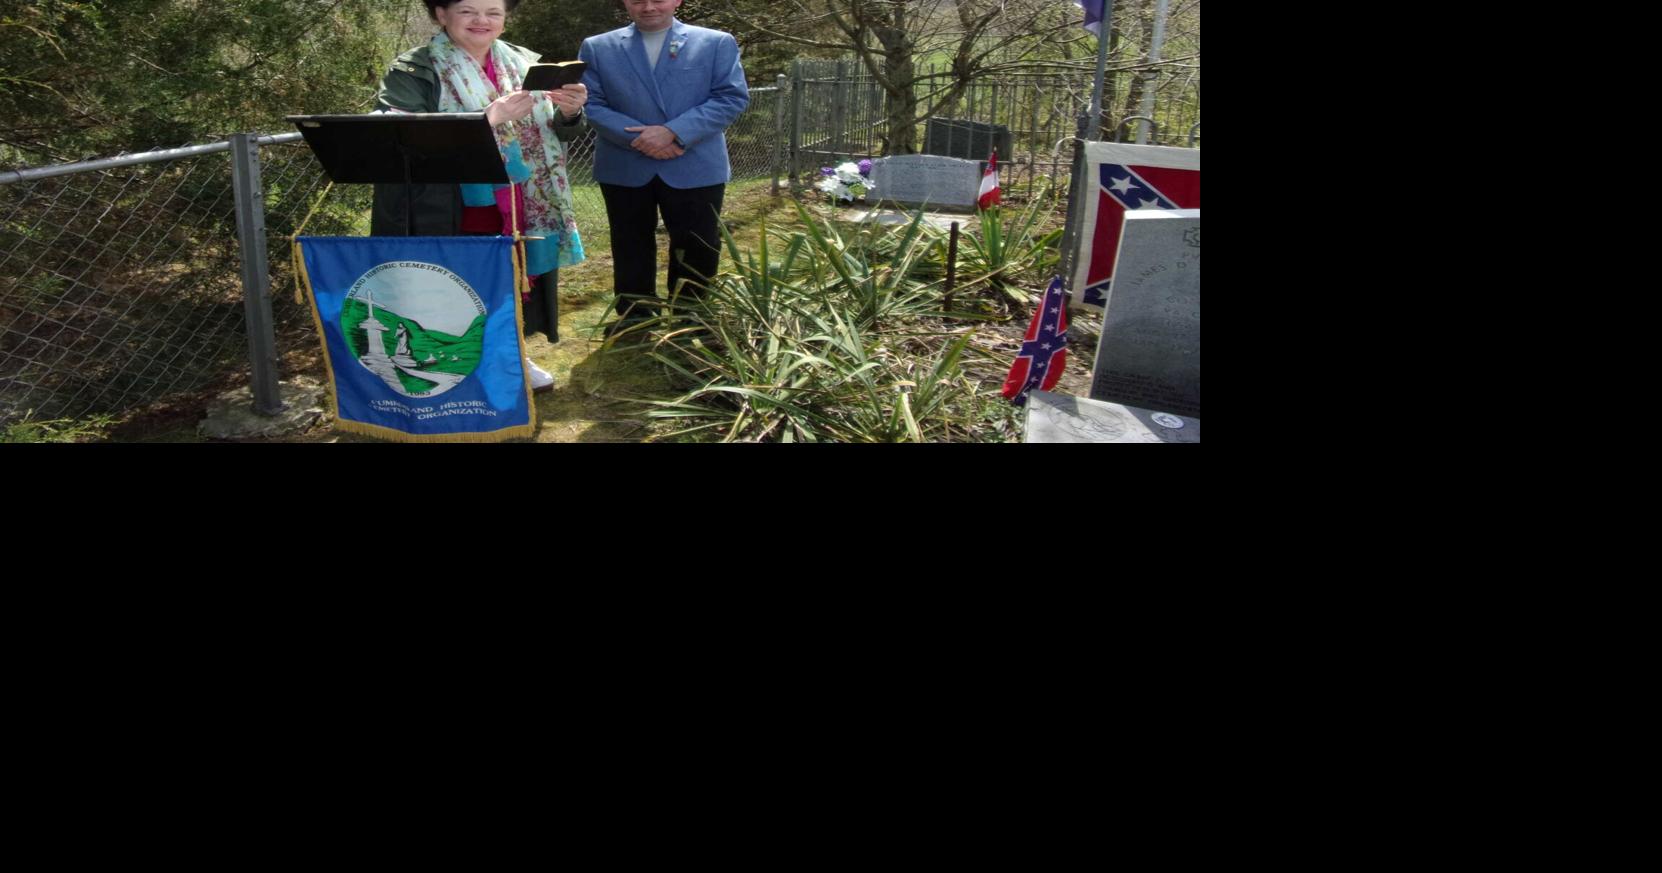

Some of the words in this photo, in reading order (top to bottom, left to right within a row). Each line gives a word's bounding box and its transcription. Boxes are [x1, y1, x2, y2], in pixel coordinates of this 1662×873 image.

[366, 263, 398, 279] HISTORIC
[399, 262, 449, 276] CEMETERY
[448, 271, 486, 315] ORGANIZATION
[440, 400, 488, 410] HISTORIC
[417, 407, 498, 420] ORGANIZATION
